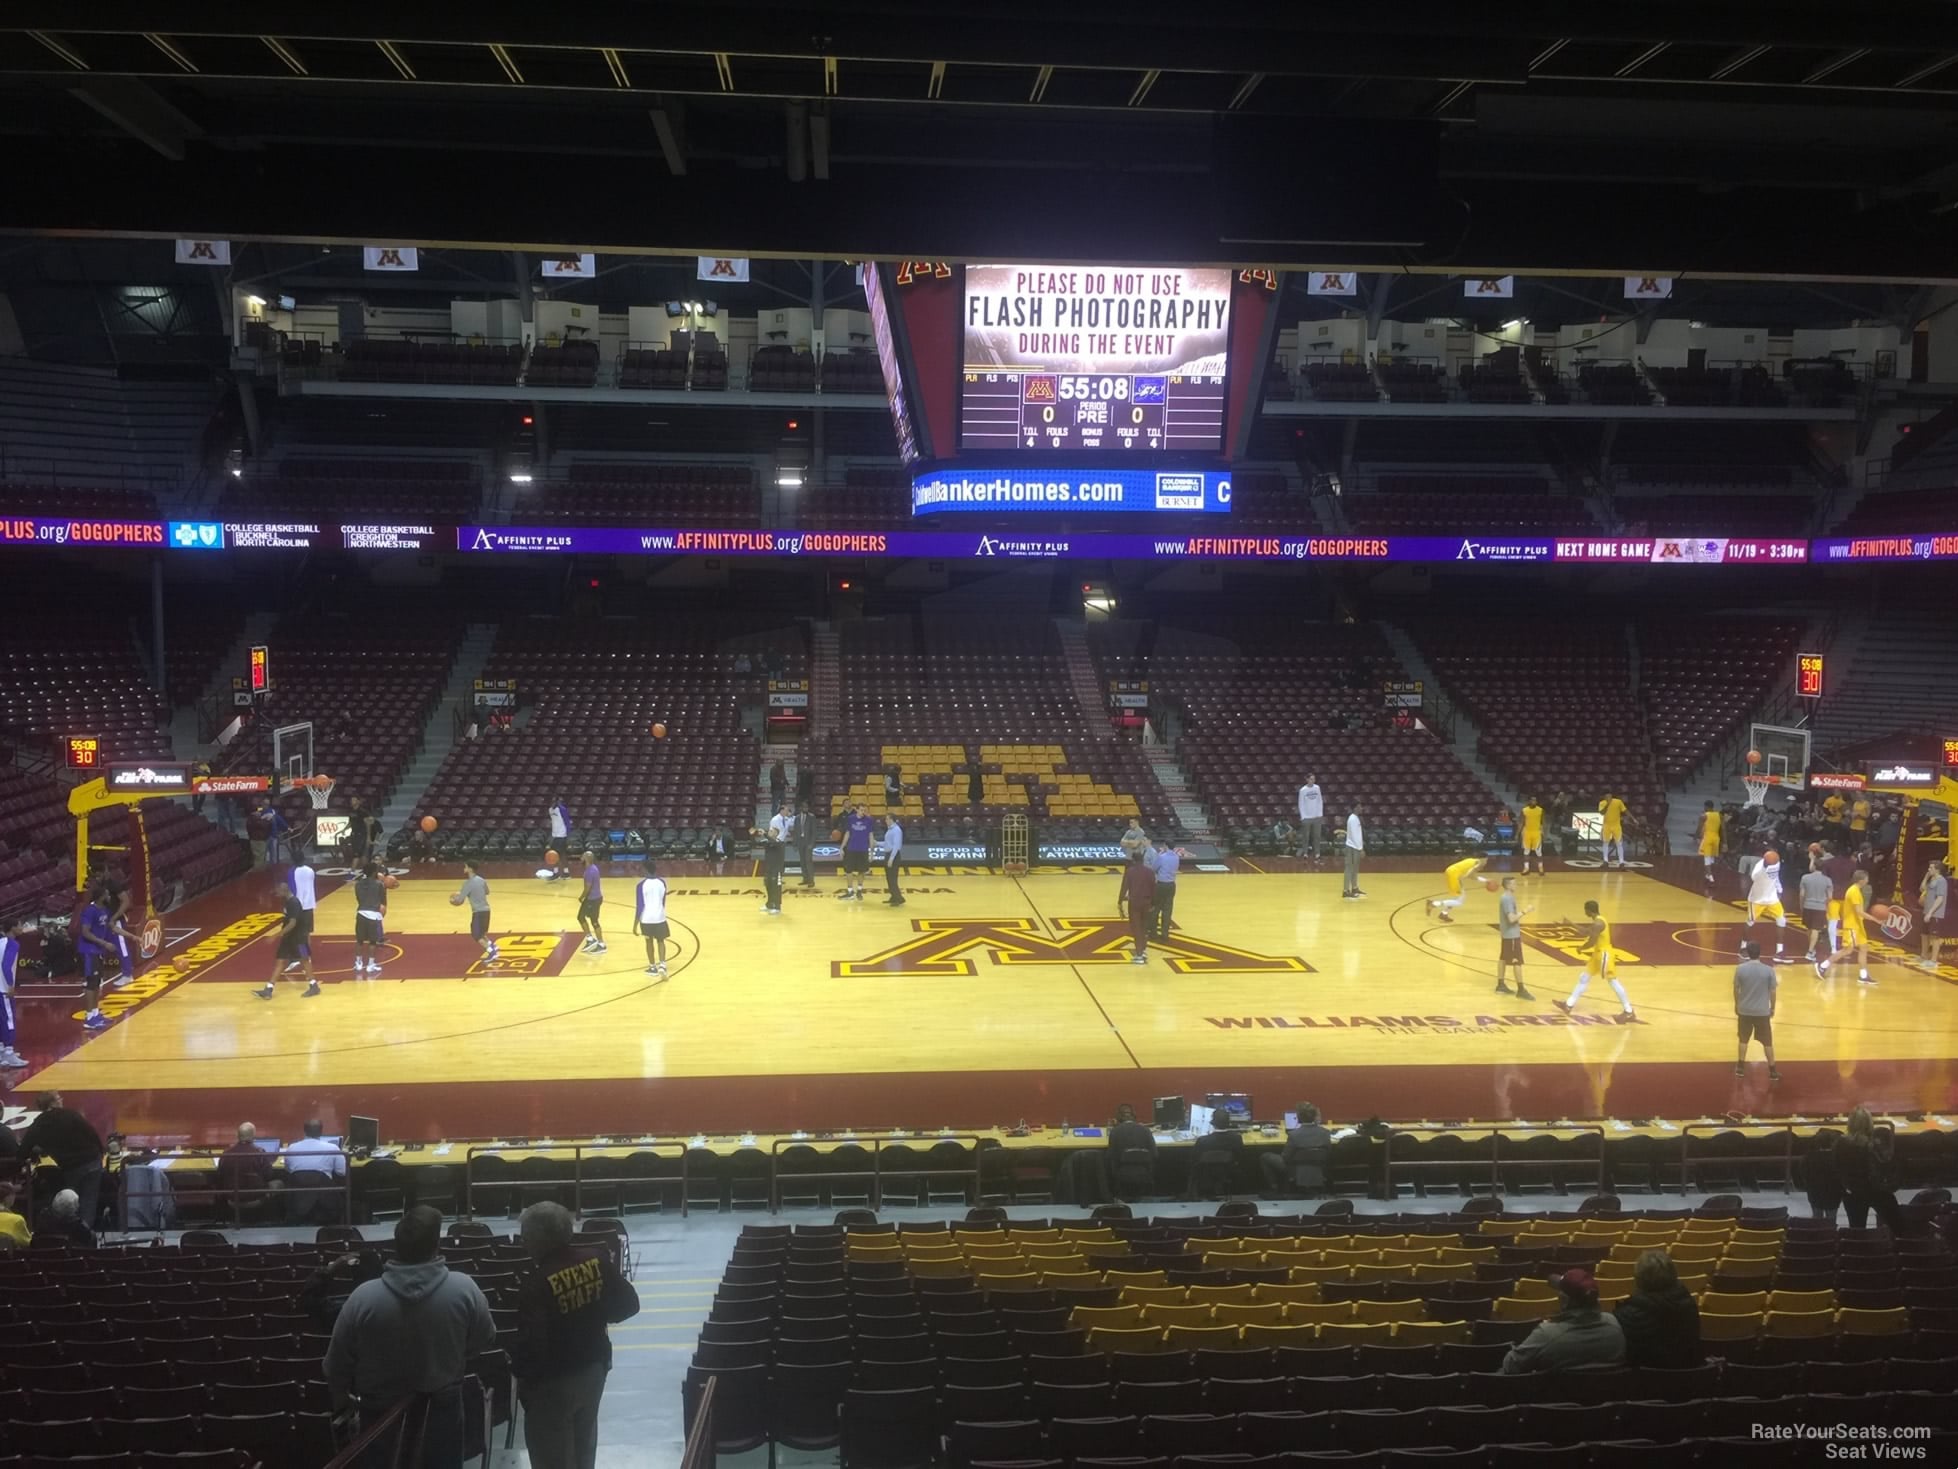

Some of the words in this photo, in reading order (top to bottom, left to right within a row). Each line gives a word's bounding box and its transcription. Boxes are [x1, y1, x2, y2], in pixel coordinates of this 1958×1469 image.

[1017, 273, 1077, 294] PLEASE
[1085, 274, 1105, 295] DO
[1113, 275, 1144, 295] NOT
[1152, 275, 1181, 296] USE
[969, 296, 1042, 327] FLASH
[1055, 298, 1227, 329] PHOTOGRAPHY
[1019, 333, 1079, 354] DURING
[1088, 334, 1117, 354] THE
[1125, 334, 1175, 355] EVENT
[1059, 377, 1128, 400] 55:08
[1080, 401, 1107, 410] PERIOD
[1043, 406, 1054, 423] 0
[1077, 410, 1108, 423] PRE
[1132, 407, 1143, 423] 0
[1046, 427, 1069, 437] FOULS
[1082, 428, 1103, 436] BONUS
[1117, 428, 1139, 437] FOULS
[1026, 437, 1035, 448] 4
[1052, 437, 1060, 448] 0
[1124, 438, 1132, 448] 0
[1149, 438, 1158, 448] 4
[225, 524, 264, 532] COLLEGE
[265, 524, 320, 533] BASKETBALL
[340, 525, 379, 533] COLLEGE
[380, 526, 435, 534] BASKETBALL
[235, 539, 265, 547] NORTH
[267, 539, 310, 547] CAROLINA
[350, 533, 398, 541] CREIGHTON
[498, 536, 542, 545] AFFINITY
[547, 537, 571, 545] PLUS
[641, 533, 887, 552] www.AFFINITYPLUS.org/GOGOPHERS
[350, 540, 420, 548] NORTHWESTERN
[999, 542, 1041, 551] AFFINITY
[1046, 543, 1069, 551] PLUS
[1154, 538, 1388, 558] www.AFFINITYPLUS.org/GOGOPHERS
[1479, 546, 1521, 554] AFFINITY
[1525, 546, 1548, 555] PLUS
[1557, 543, 1584, 557] NEXT
[1588, 543, 1617, 557] HOME
[1621, 543, 1650, 558] GAME
[1729, 544, 1756, 559] 11/19
[1769, 544, 1805, 558] 3:30PM
[1801, 658, 1822, 670] 55:08
[1803, 672, 1818, 691] 30
[71, 741, 97, 751] 55:08
[76, 752, 93, 763] 30
[1895, 809, 1911, 889] MINNESOTA
[1886, 913, 1909, 934] DQ
[142, 930, 158, 949] DQ
[171, 913, 284, 963] GOPHERS
[831, 917, 1319, 979] M
[1203, 1015, 1463, 1029] WILLIAMS
[1474, 1014, 1651, 1027] ARENA
[1373, 1026, 1422, 1036] THE
[1432, 1025, 1508, 1035] BARN
[547, 1257, 602, 1296] EVENT
[557, 1279, 604, 1315] STAFF
